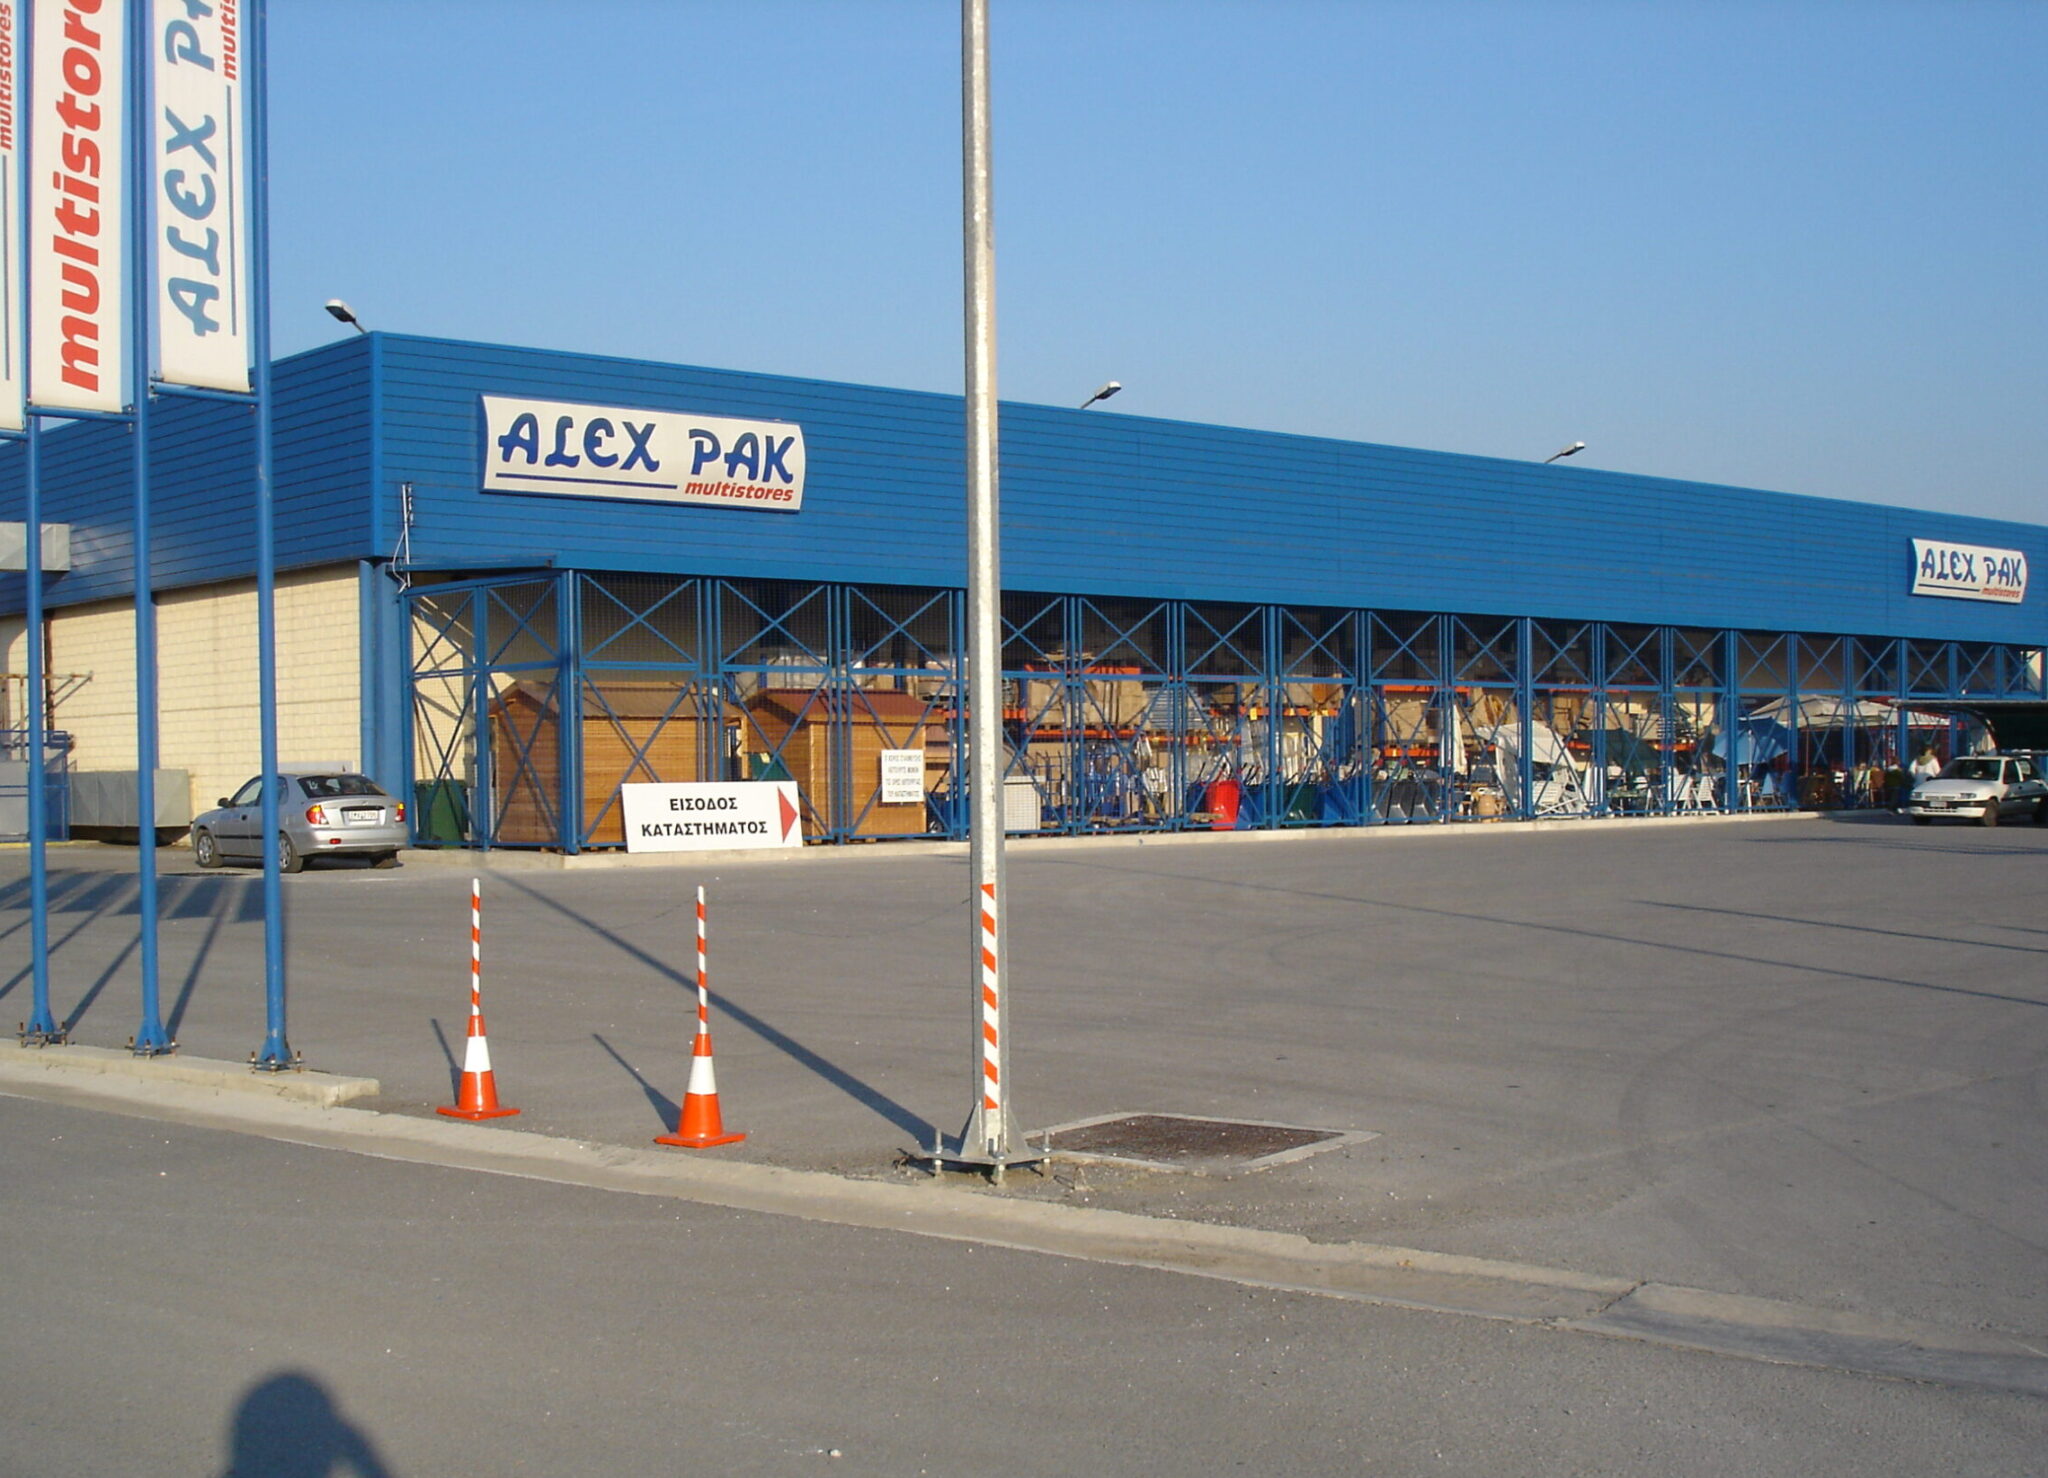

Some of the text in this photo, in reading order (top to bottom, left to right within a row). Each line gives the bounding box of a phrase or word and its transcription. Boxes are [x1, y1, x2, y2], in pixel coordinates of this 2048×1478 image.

[164, 105, 220, 337] ALEX
[498, 412, 796, 484] ALEX PAK
[684, 480, 794, 502] multistores
[1921, 548, 2022, 587] ALEX PAK
[669, 797, 738, 812] ΕΙΣΟΔΟΣ
[641, 820, 768, 837] ΚΑΤΑΣΤΗΜΑΤΟΣ
